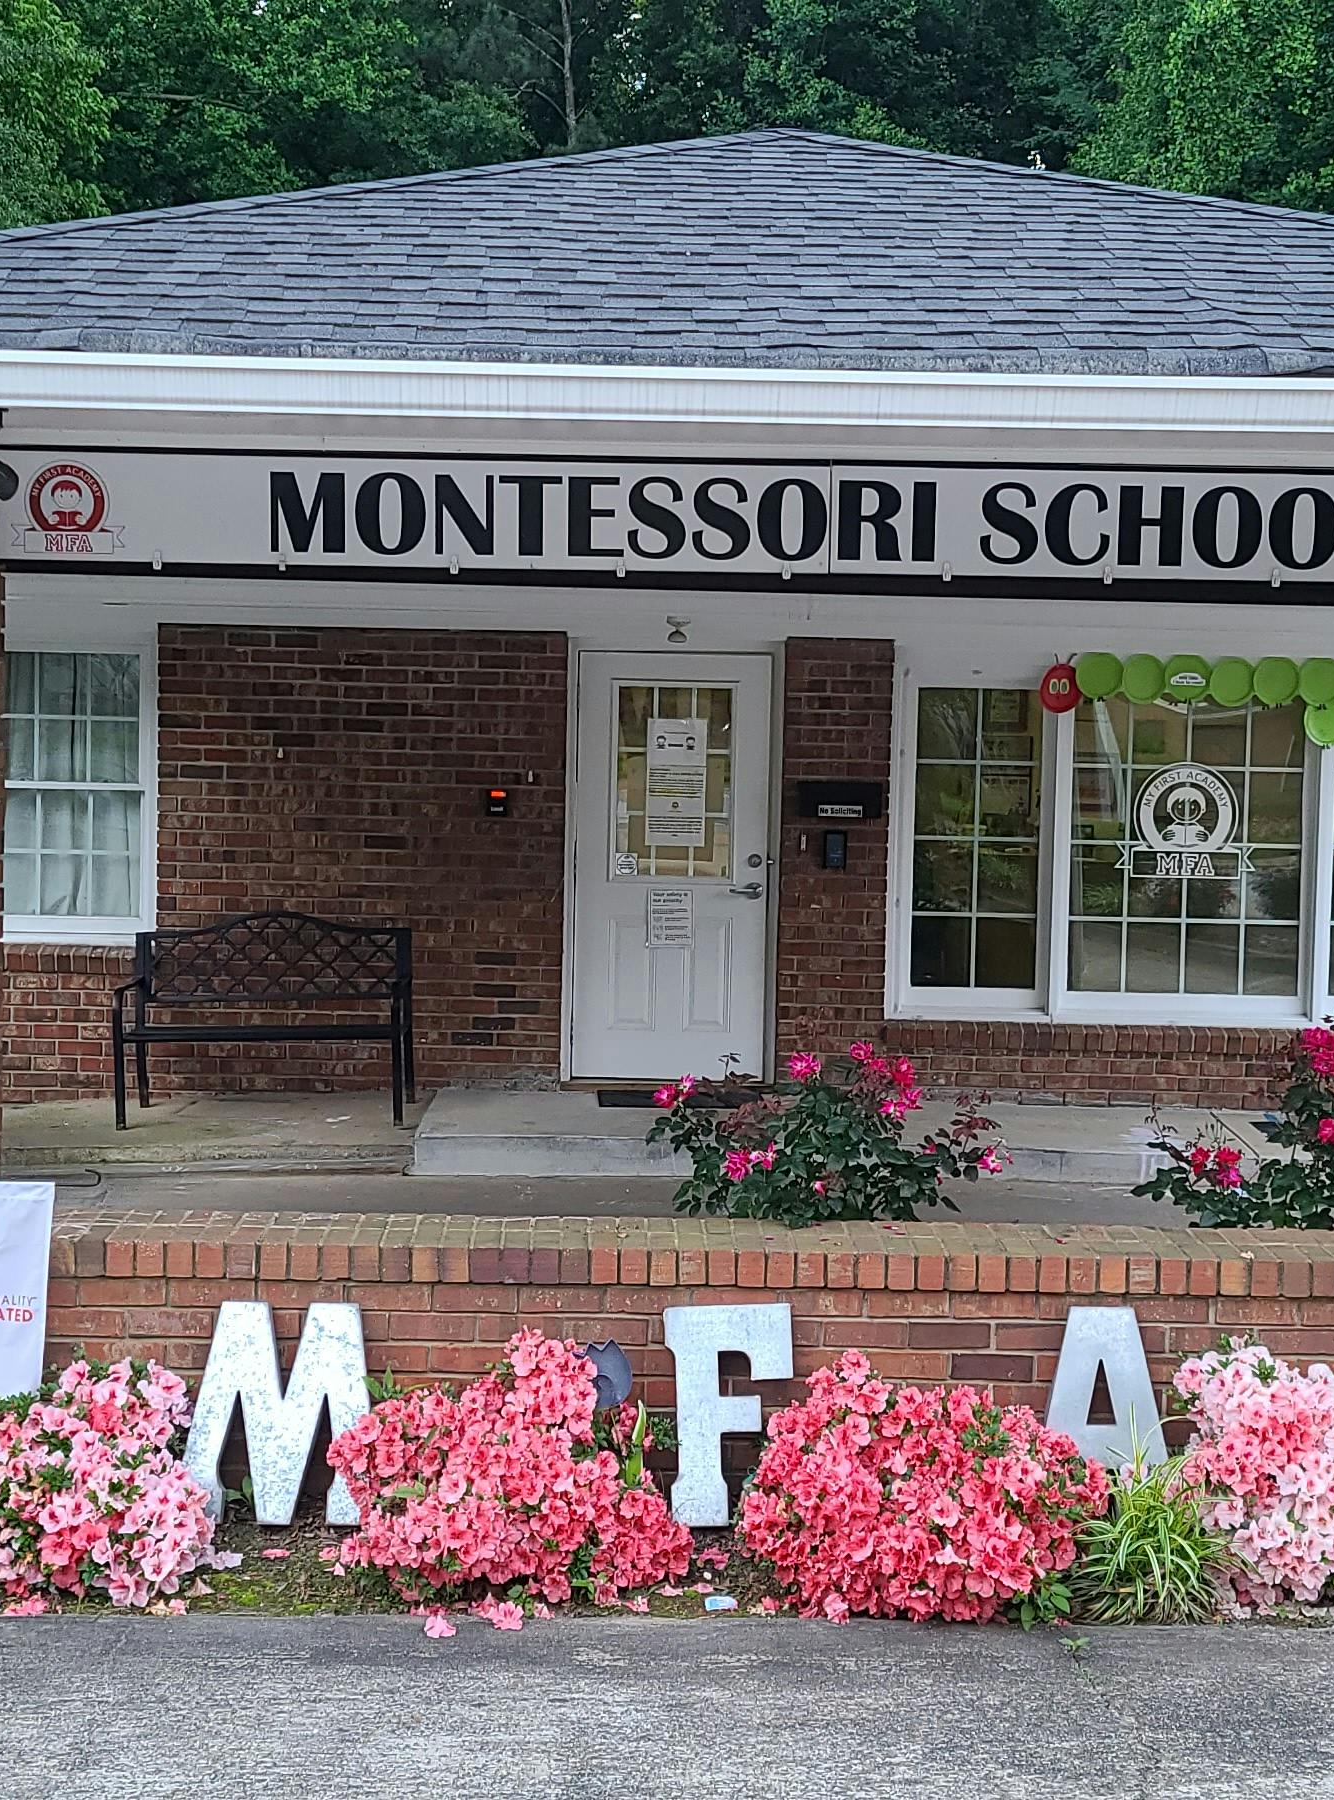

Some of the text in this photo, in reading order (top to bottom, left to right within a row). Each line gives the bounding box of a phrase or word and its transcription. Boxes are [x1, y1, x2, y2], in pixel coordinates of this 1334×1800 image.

[32, 466, 102, 497] MY FIRST ACADEMY
[269, 471, 937, 562] MONTESSORI
[45, 533, 93, 552] MFA
[1143, 771, 1229, 808] MY FIRST ACADEMY
[1156, 853, 1215, 876] MFA
